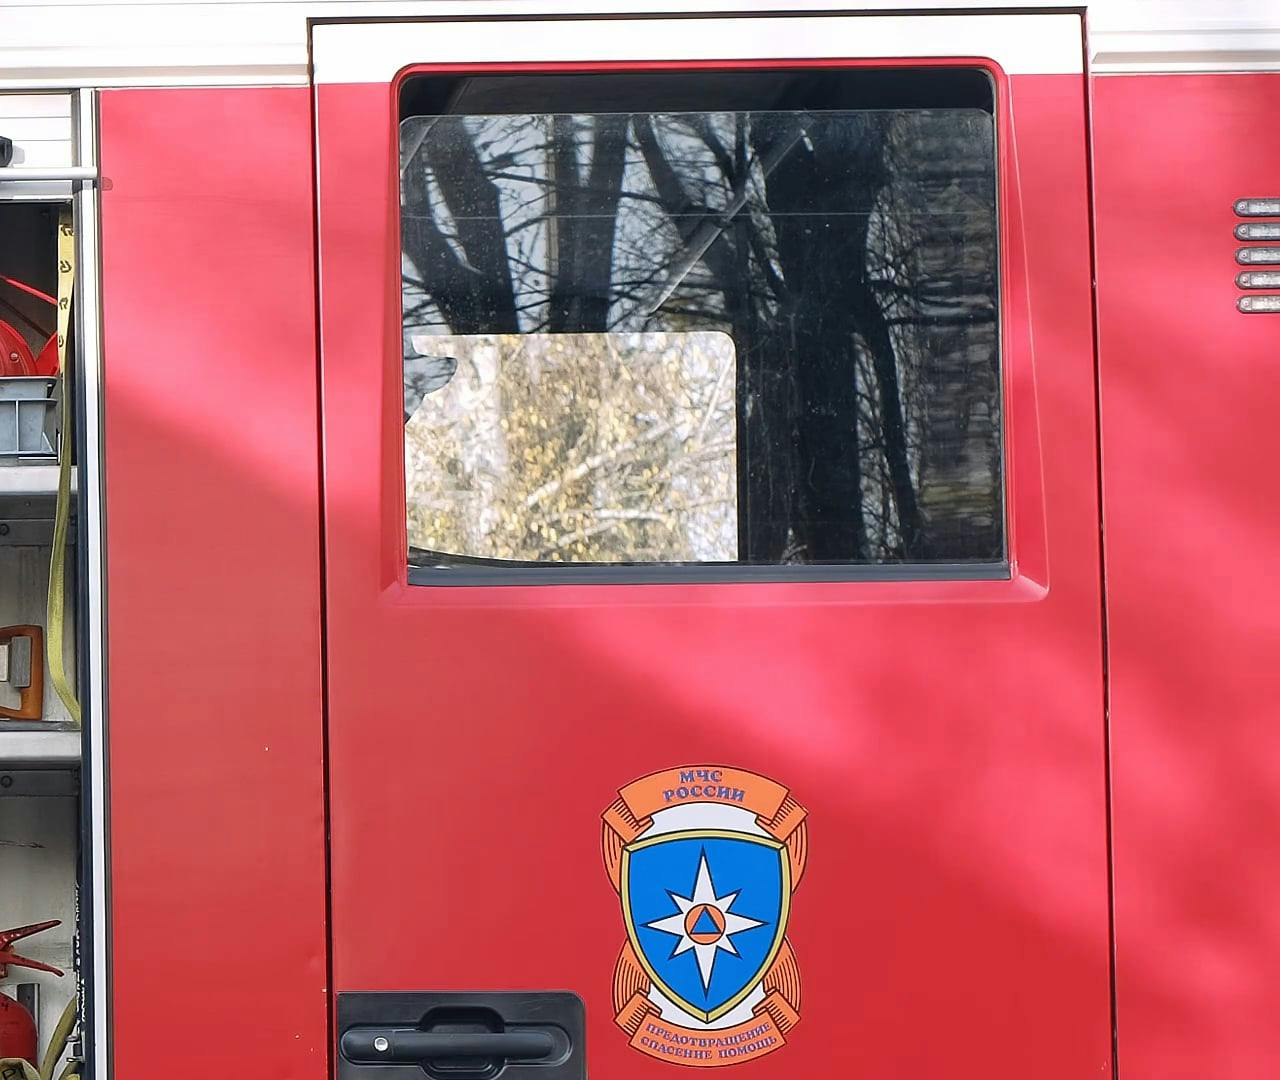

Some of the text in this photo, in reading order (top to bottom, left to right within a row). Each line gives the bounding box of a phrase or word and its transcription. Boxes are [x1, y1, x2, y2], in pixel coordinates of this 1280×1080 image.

[680, 769, 723, 783] МЧС
[663, 785, 746, 802] РОССИИ
[646, 1021, 771, 1048] ПРЕДОТВРАЩЕНИЕ
[718, 1035, 778, 1059] ПОМОЩЬ
